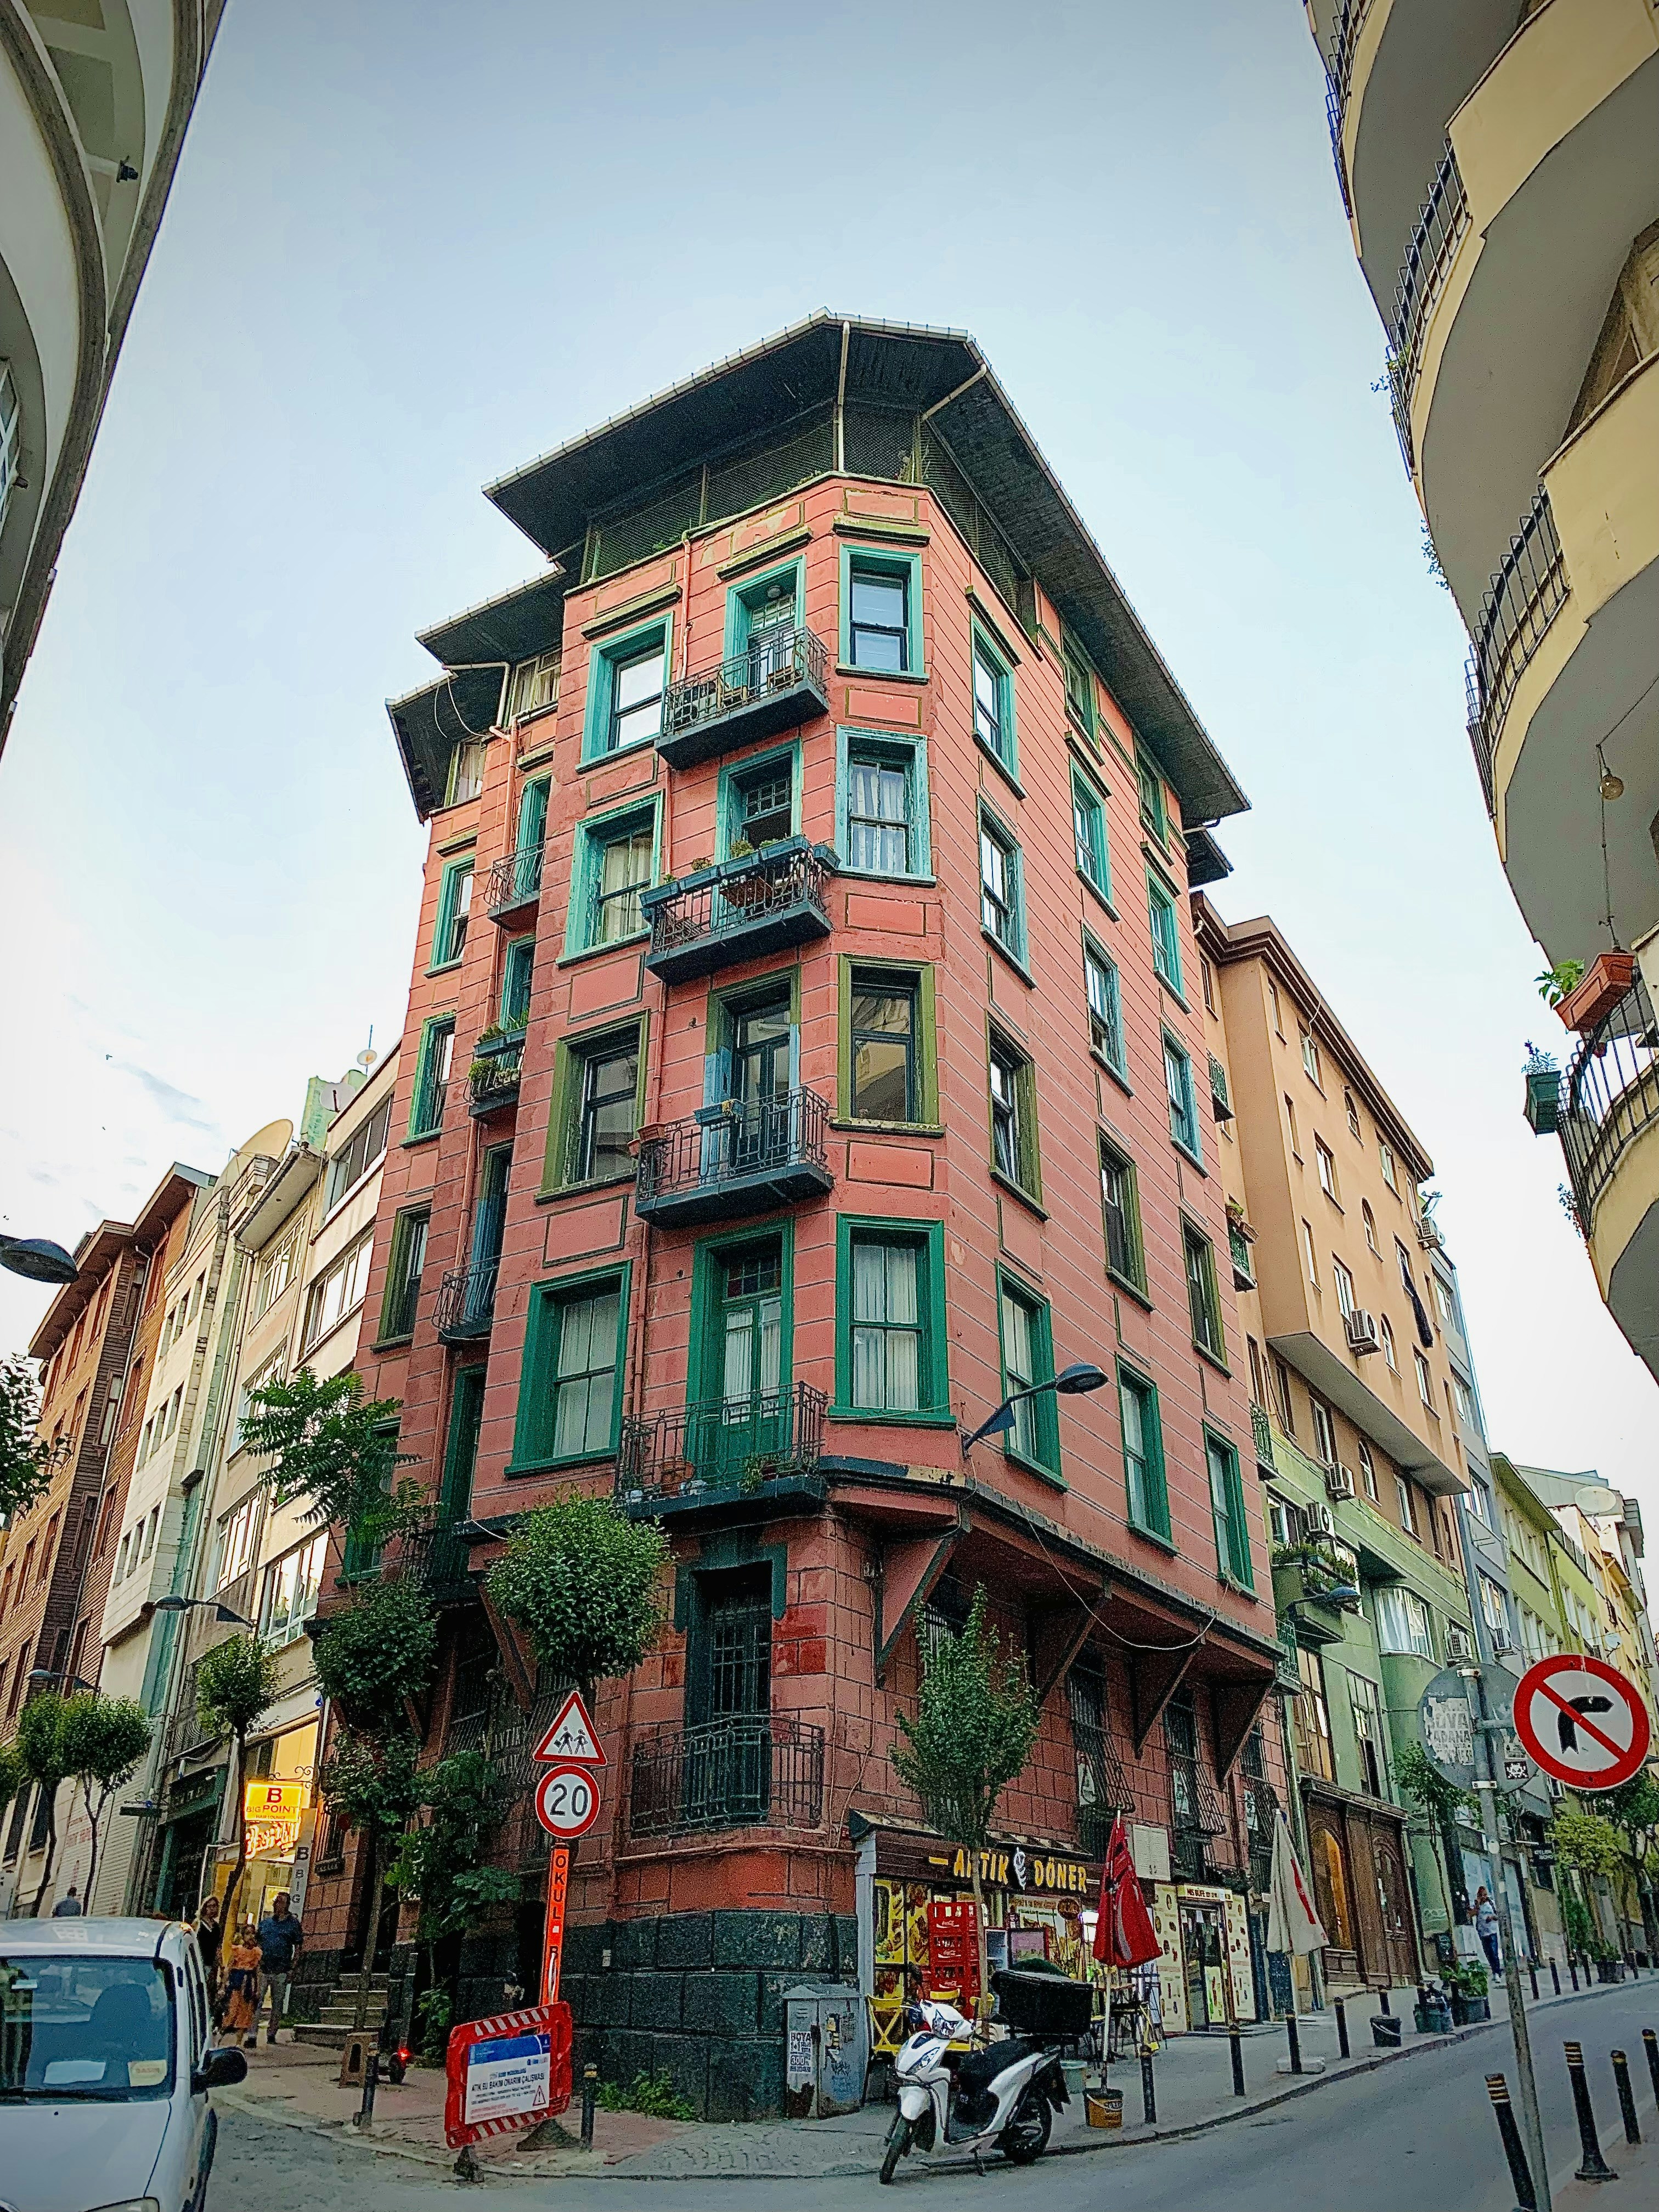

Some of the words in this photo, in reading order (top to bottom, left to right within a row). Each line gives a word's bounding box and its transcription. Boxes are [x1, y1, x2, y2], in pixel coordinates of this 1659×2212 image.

[266, 1787, 282, 1803] B
[550, 1783, 588, 1817] 20
[263, 1805, 298, 1814] POINT
[297, 1847, 309, 1860] B
[1034, 1856, 1087, 1893] DÖNER
[291, 1869, 304, 1904] BIG
[552, 1855, 567, 1920] OKUL
[790, 2032, 811, 2042] BOYA
[489, 2080, 503, 2089] BAKIM
[504, 2078, 521, 2086] ONARIM
